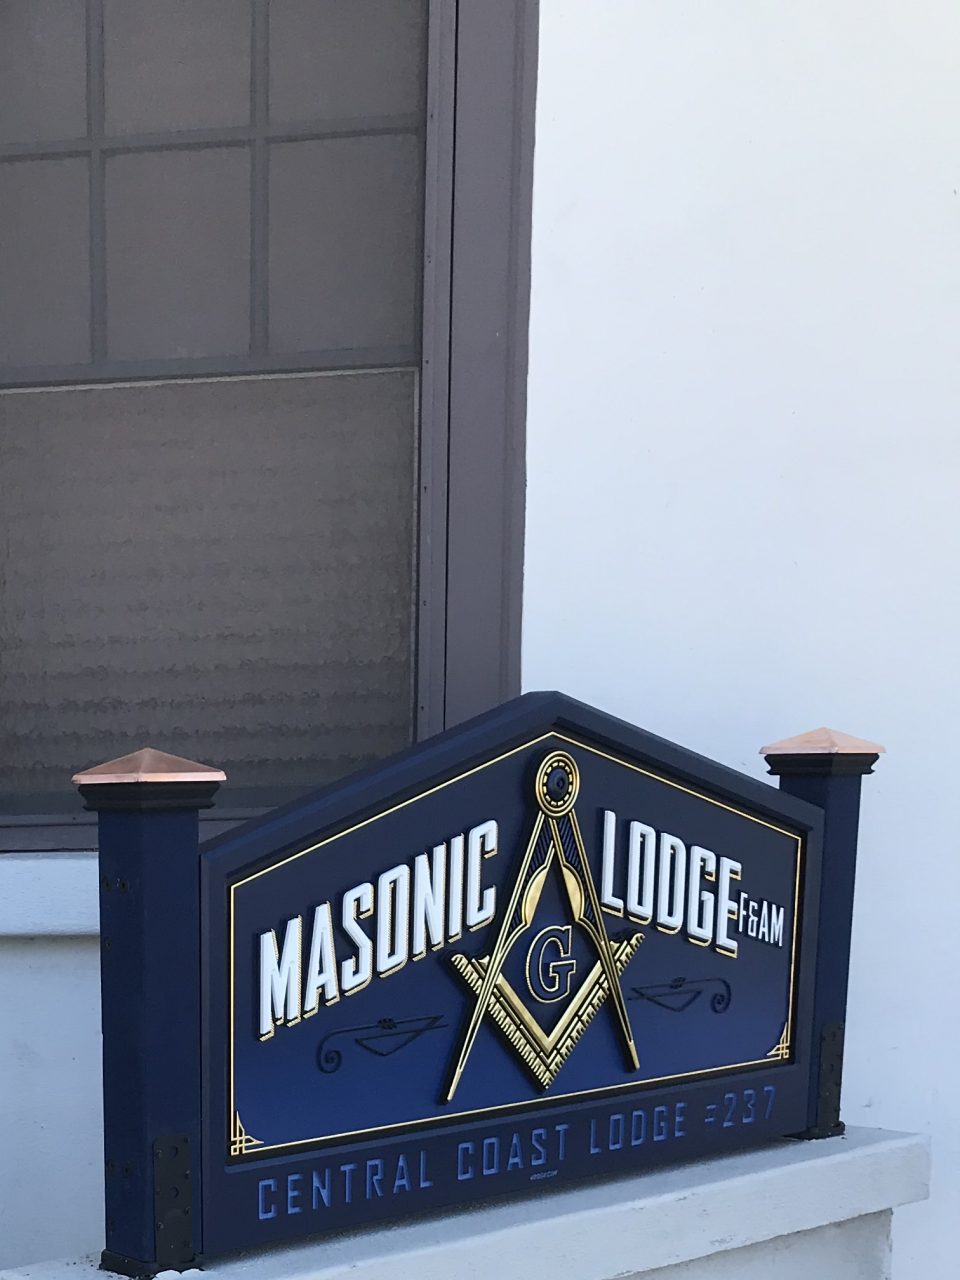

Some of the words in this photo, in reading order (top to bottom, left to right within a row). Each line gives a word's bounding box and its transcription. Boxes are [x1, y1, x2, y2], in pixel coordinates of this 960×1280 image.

[259, 819, 500, 1043] MASONIC
[600, 809, 742, 959] LODGE
[737, 892, 784, 948] F&AM
[525, 925, 575, 1003] G
[257, 1149, 434, 1221] CENTRAL
[457, 1123, 570, 1182] COAST
[589, 1102, 686, 1156] LODGE
